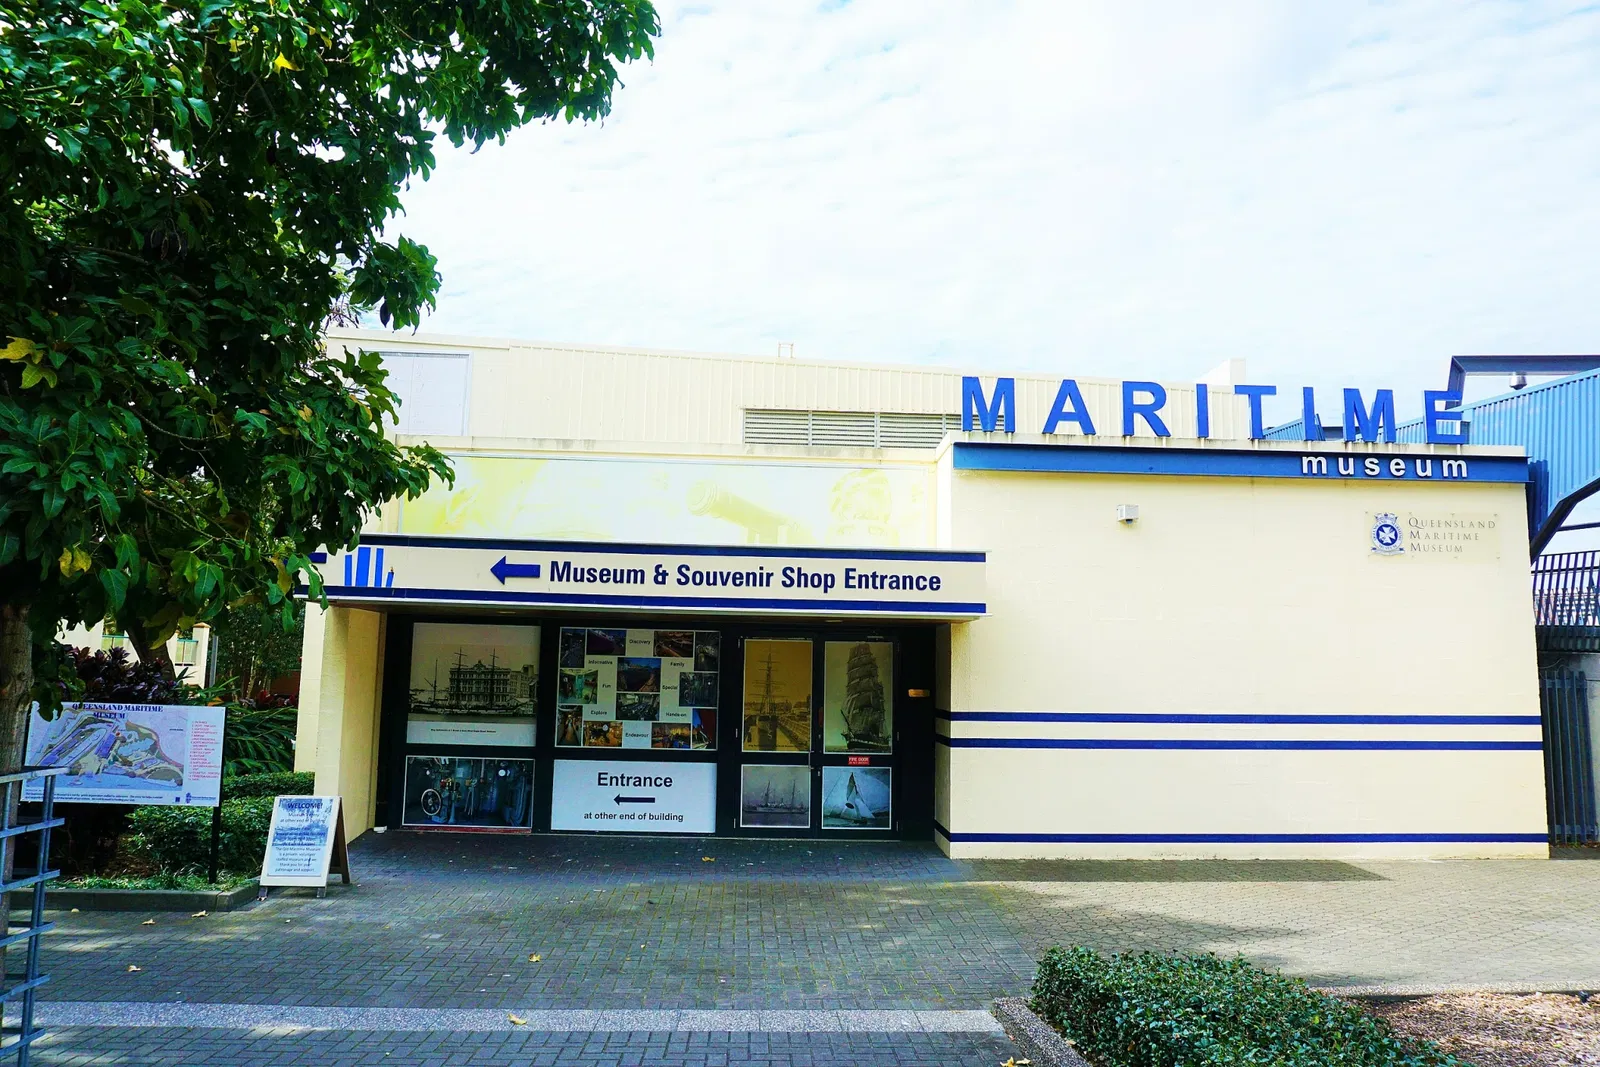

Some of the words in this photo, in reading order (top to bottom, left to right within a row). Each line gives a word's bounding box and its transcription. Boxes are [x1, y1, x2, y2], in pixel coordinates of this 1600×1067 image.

[961, 376, 1469, 444] MARITIME
[1302, 452, 1467, 478] museum
[1408, 516, 1496, 529] QUEENSLAND
[1409, 530, 1480, 541] MARITIME
[1410, 542, 1463, 553] MUSEUM
[550, 560, 645, 585] Museum
[653, 563, 669, 585] &
[676, 564, 774, 588] Souvenir
[781, 566, 835, 593] Shop
[844, 568, 941, 591] Entrance
[124, 704, 163, 712] MARITIME
[597, 772, 673, 788] Entrance
[583, 812, 592, 820] at
[594, 812, 617, 820] other
[619, 812, 636, 821] end
[638, 812, 647, 821] of
[648, 812, 684, 823] building
